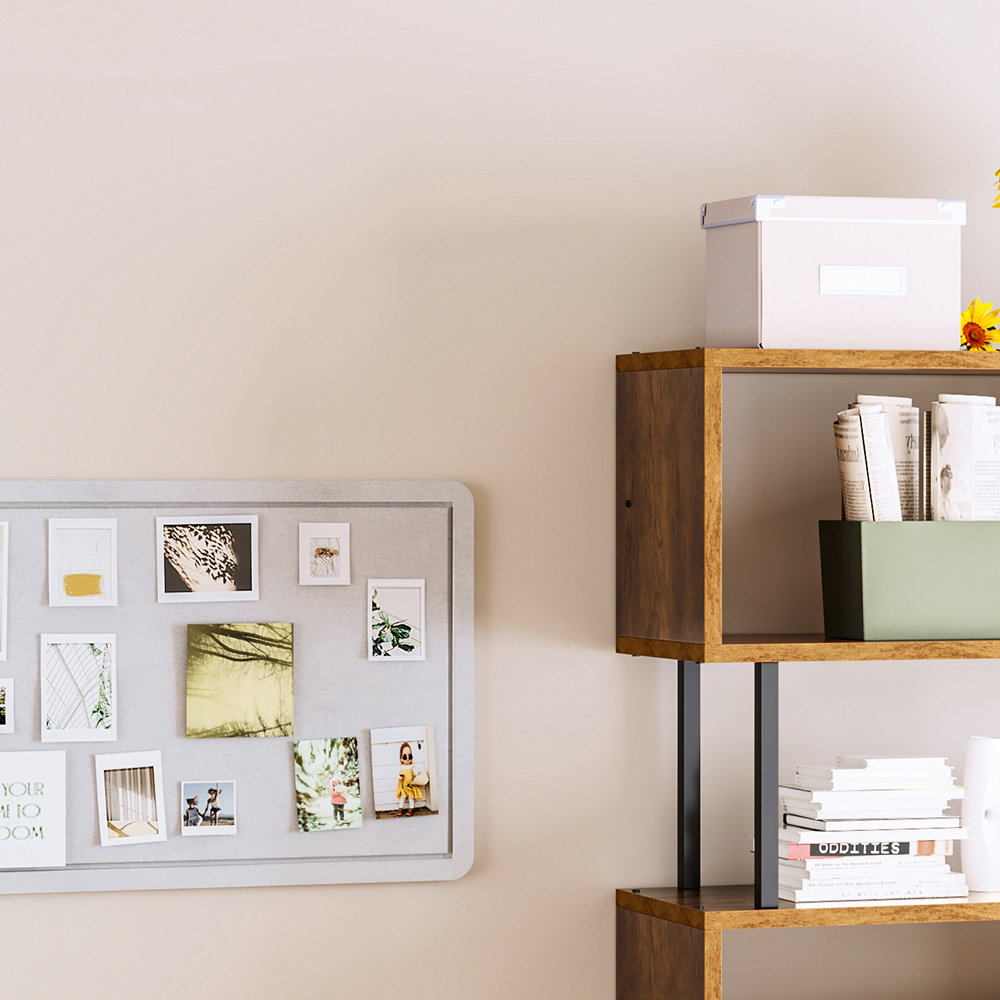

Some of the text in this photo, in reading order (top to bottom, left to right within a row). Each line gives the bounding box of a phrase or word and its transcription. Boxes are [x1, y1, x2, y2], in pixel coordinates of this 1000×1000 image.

[1, 782, 45, 797] YOUR
[17, 803, 41, 818] TO
[818, 842, 901, 854] ODDITIES
